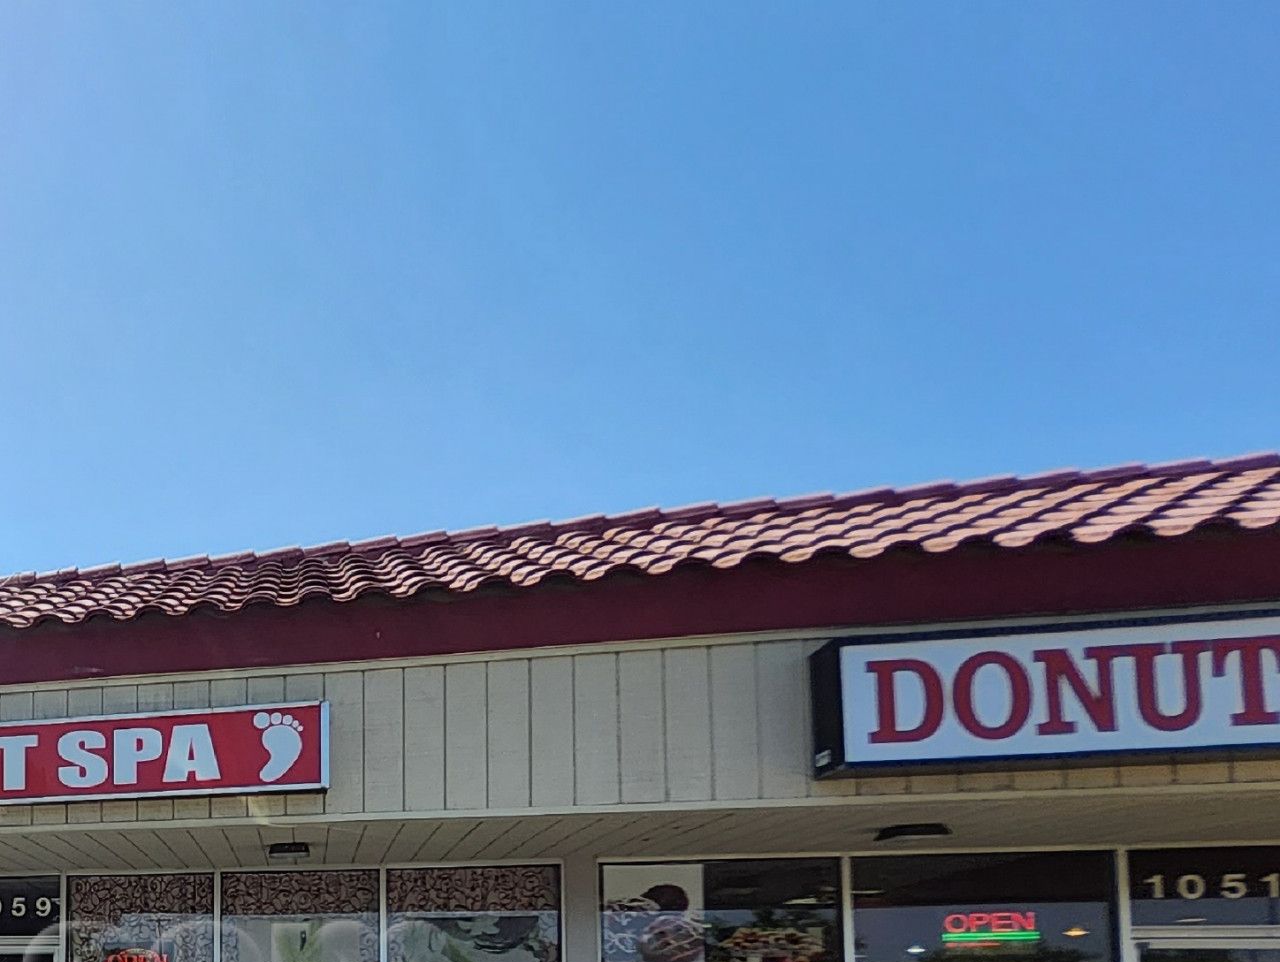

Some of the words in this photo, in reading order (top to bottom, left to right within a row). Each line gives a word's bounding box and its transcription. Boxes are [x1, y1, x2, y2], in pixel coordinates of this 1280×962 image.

[866, 634, 1280, 744] DONUT
[57, 723, 222, 789] SPA
[1143, 873, 1280, 899] 1051
[944, 912, 1036, 932] OPEN
